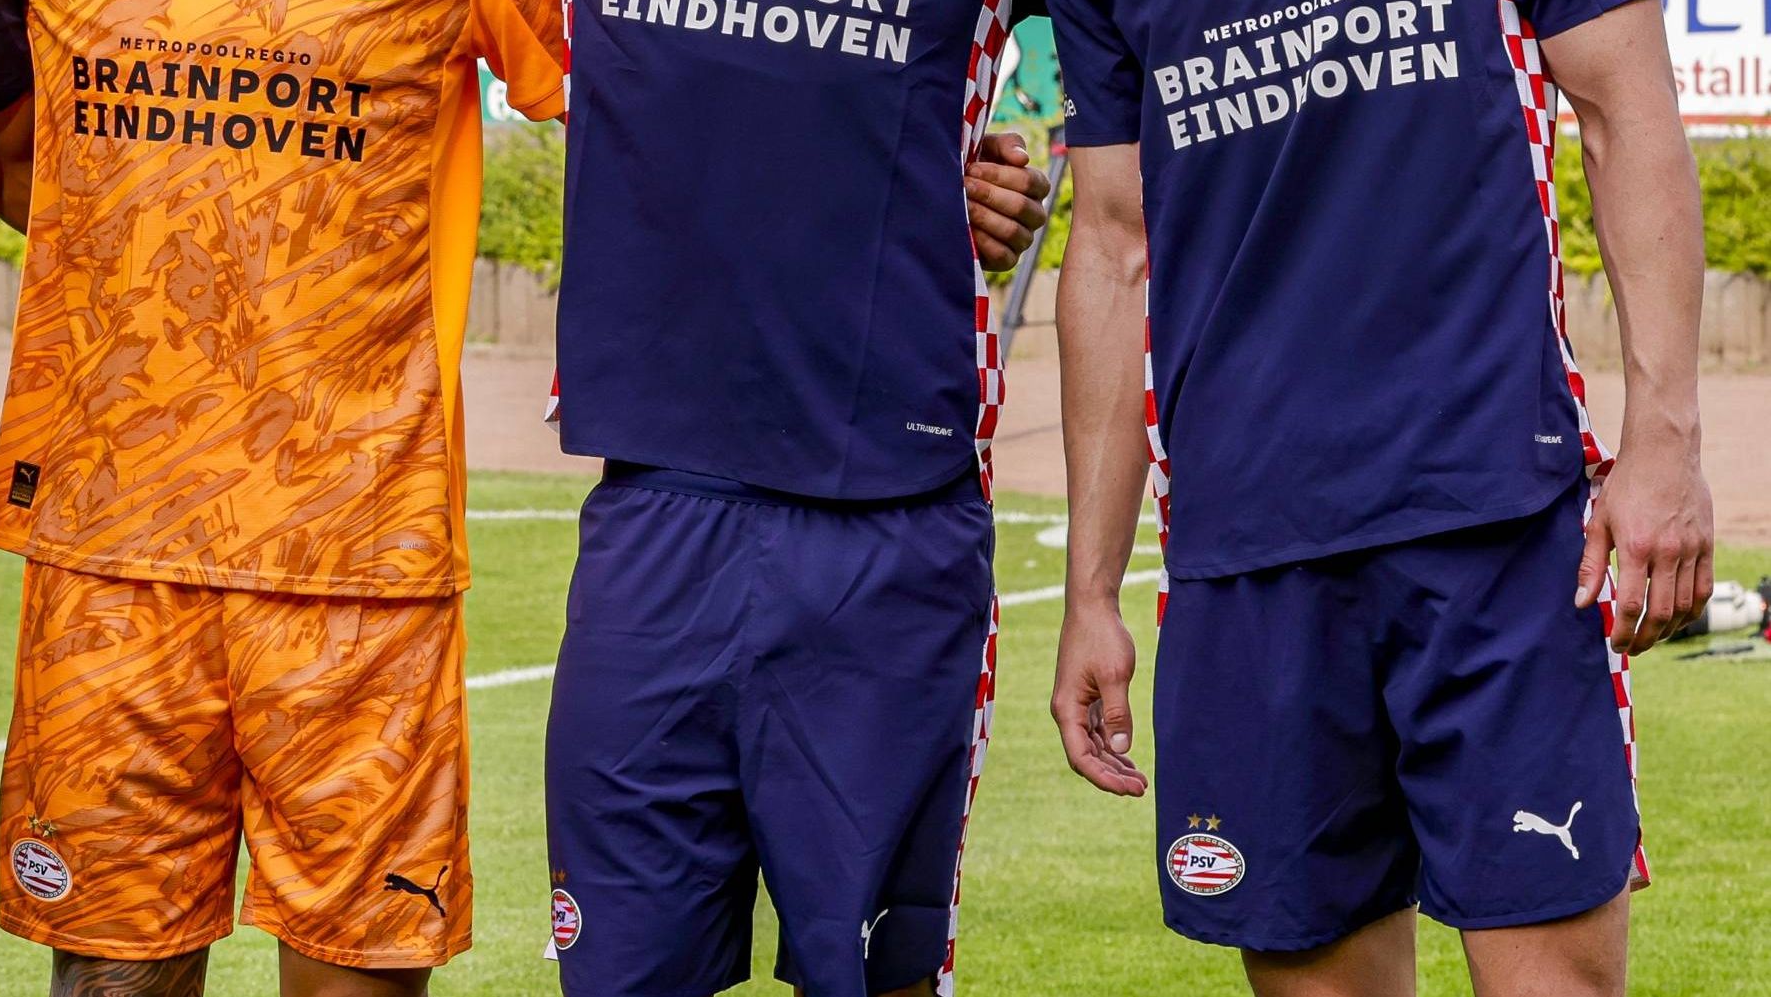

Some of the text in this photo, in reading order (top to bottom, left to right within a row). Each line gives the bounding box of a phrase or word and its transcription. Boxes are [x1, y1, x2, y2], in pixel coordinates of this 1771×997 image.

[120, 37, 312, 66] METROPOOLREGIO
[72, 55, 372, 118] BRAINPORT
[1167, 40, 1459, 151] EINDHOVEN
[74, 99, 367, 163] EINDHOVEN
[28, 860, 48, 876] PSV
[1189, 855, 1217, 869] PSV
